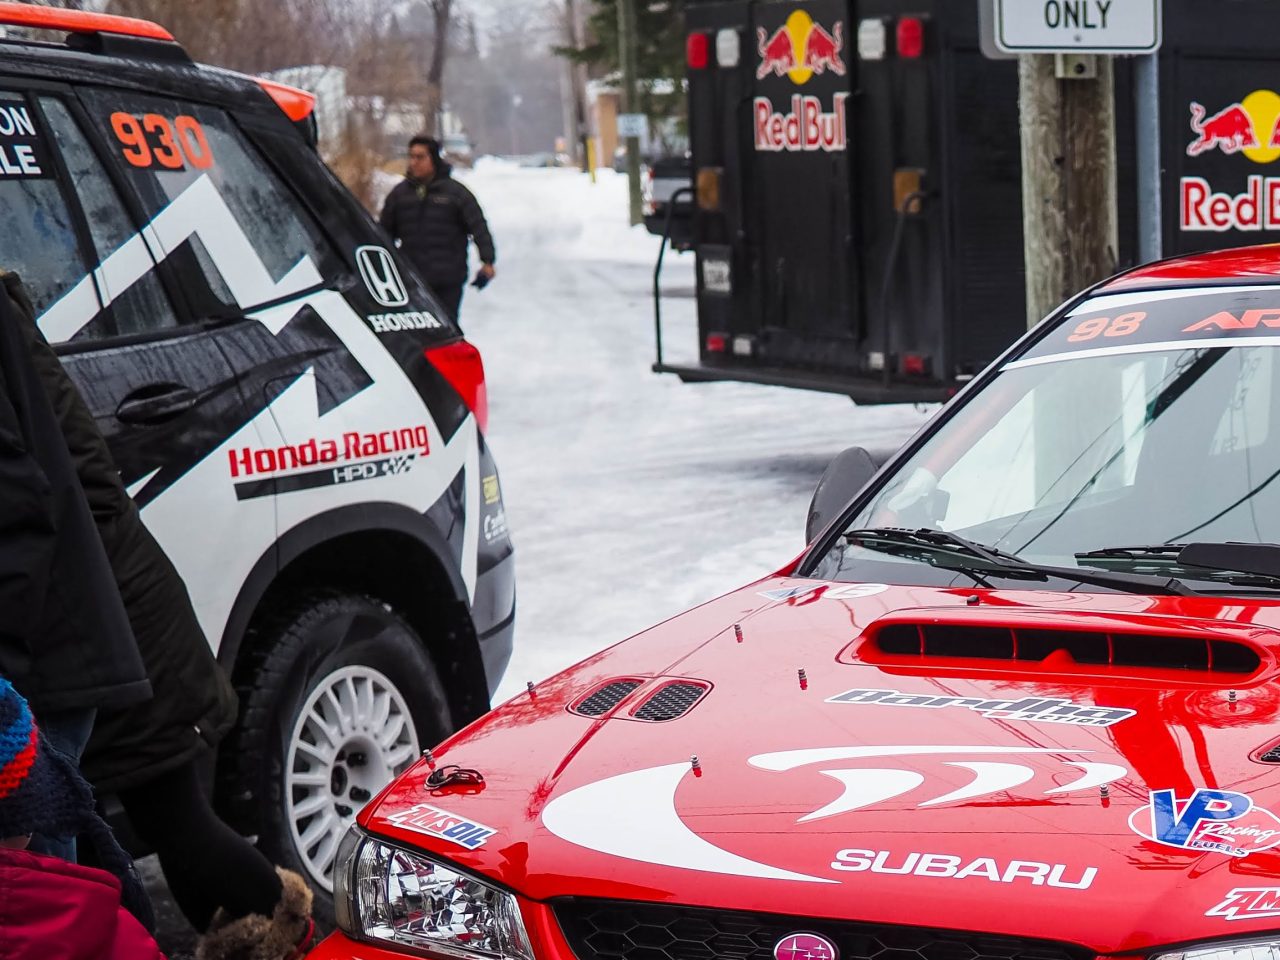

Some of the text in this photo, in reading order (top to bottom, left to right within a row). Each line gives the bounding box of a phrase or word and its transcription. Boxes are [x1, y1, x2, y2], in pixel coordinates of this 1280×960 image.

[1045, 0, 1111, 28] ONLY
[754, 94, 801, 151] Red
[110, 111, 214, 170] 930
[0, 145, 42, 174] LE
[1181, 175, 1264, 231] Red
[368, 311, 441, 333] HONDA
[1067, 311, 1147, 343] 98
[228, 425, 430, 477] Honda Racing
[333, 463, 376, 483] HPD
[828, 690, 1135, 721] Bardha
[387, 804, 498, 850] AMSOIL
[1149, 788, 1253, 847] VP
[1196, 822, 1279, 844] Racing
[1192, 840, 1246, 856] FUELS
[831, 849, 1098, 889] SUBARU
